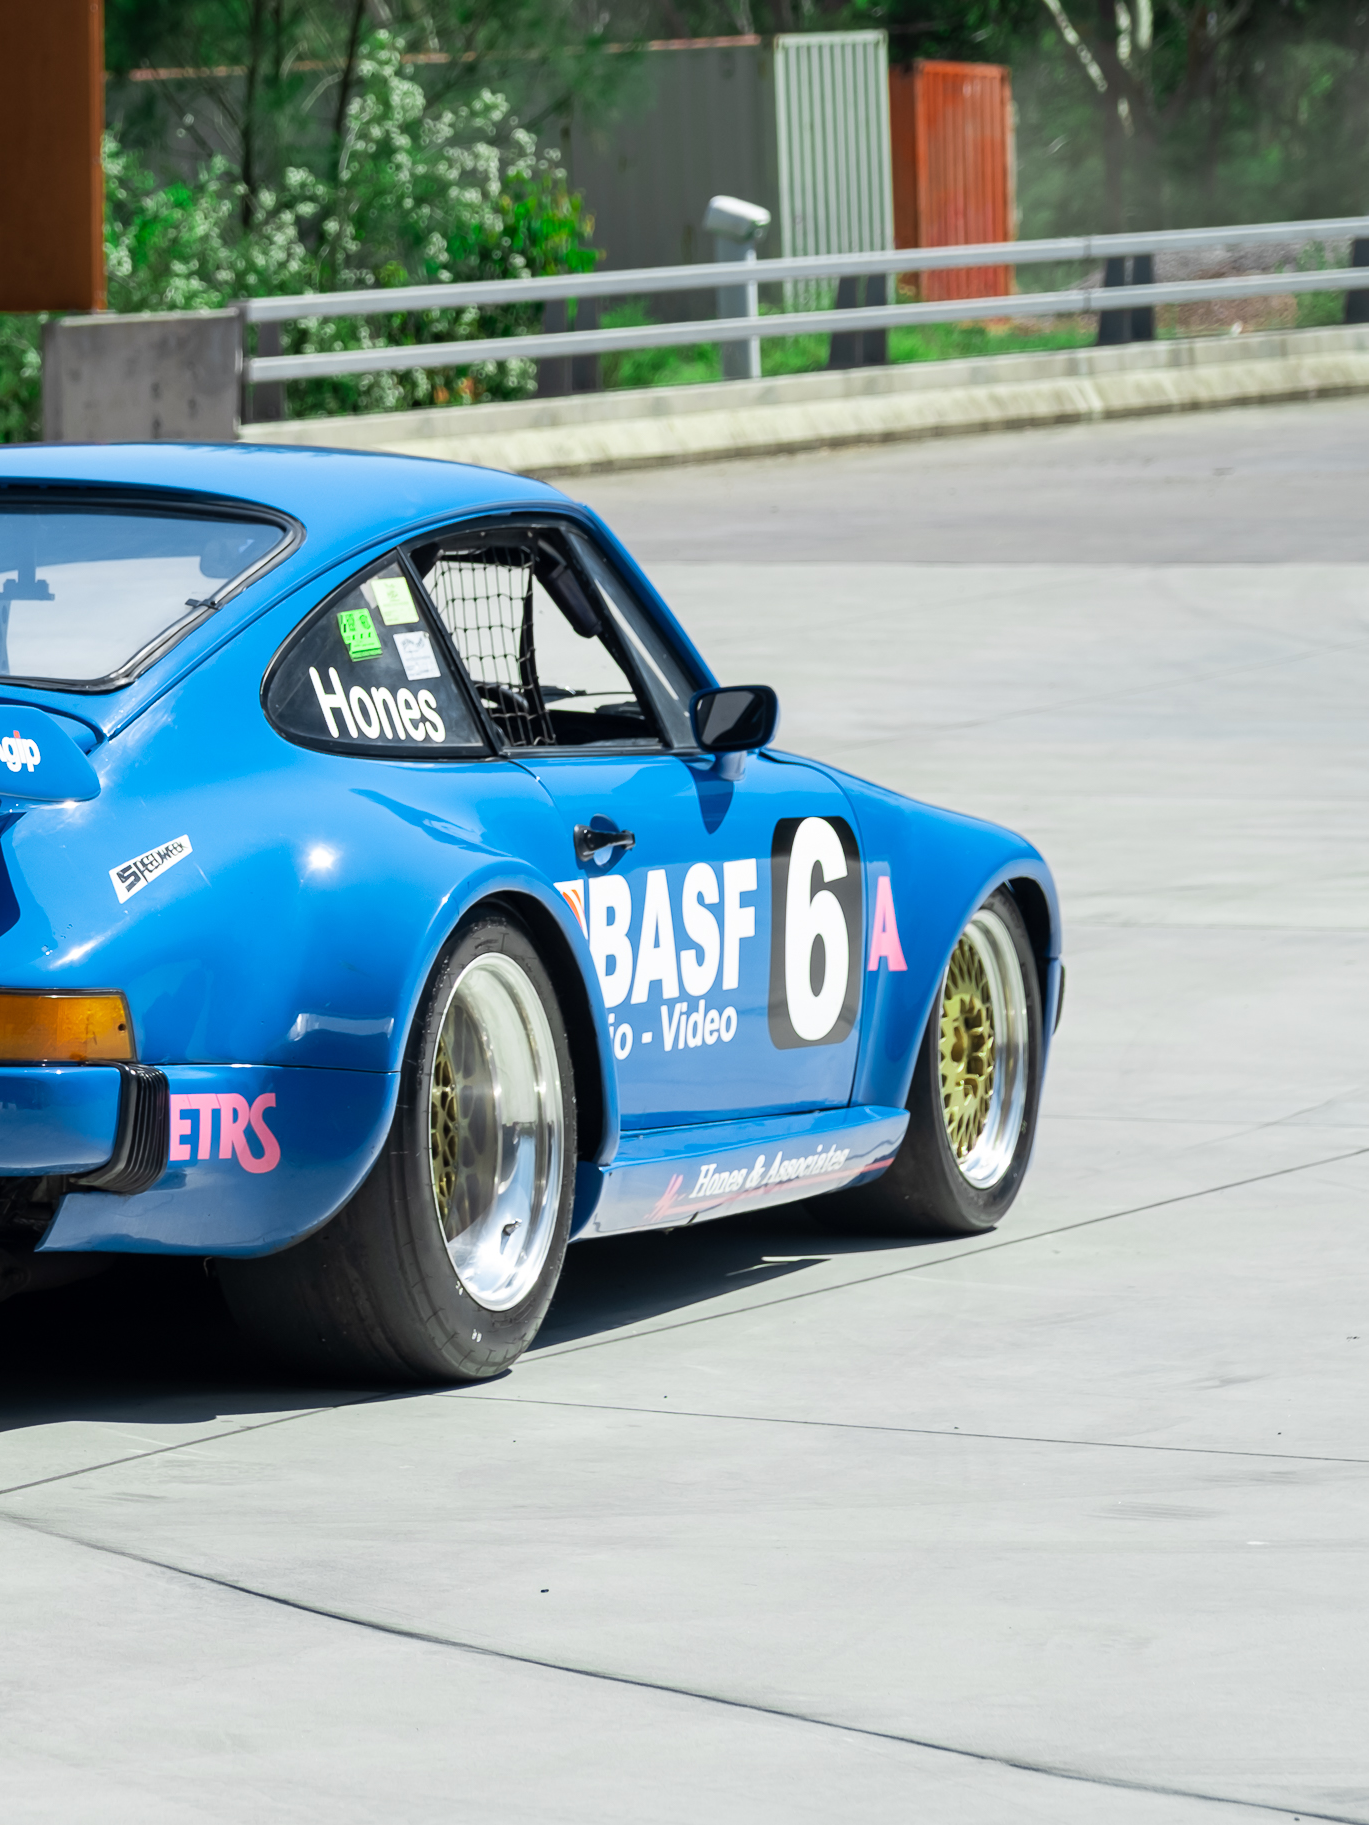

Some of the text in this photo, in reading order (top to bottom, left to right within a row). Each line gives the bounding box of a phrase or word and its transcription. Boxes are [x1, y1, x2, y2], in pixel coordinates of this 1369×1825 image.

[309, 666, 446, 743] Hones
[588, 857, 758, 1009] BASF
[784, 816, 850, 1042] 6
[867, 875, 908, 971] A
[660, 999, 738, 1053] Video
[169, 1092, 281, 1174] ETRS
[688, 1143, 851, 1199] Hones & Associates
